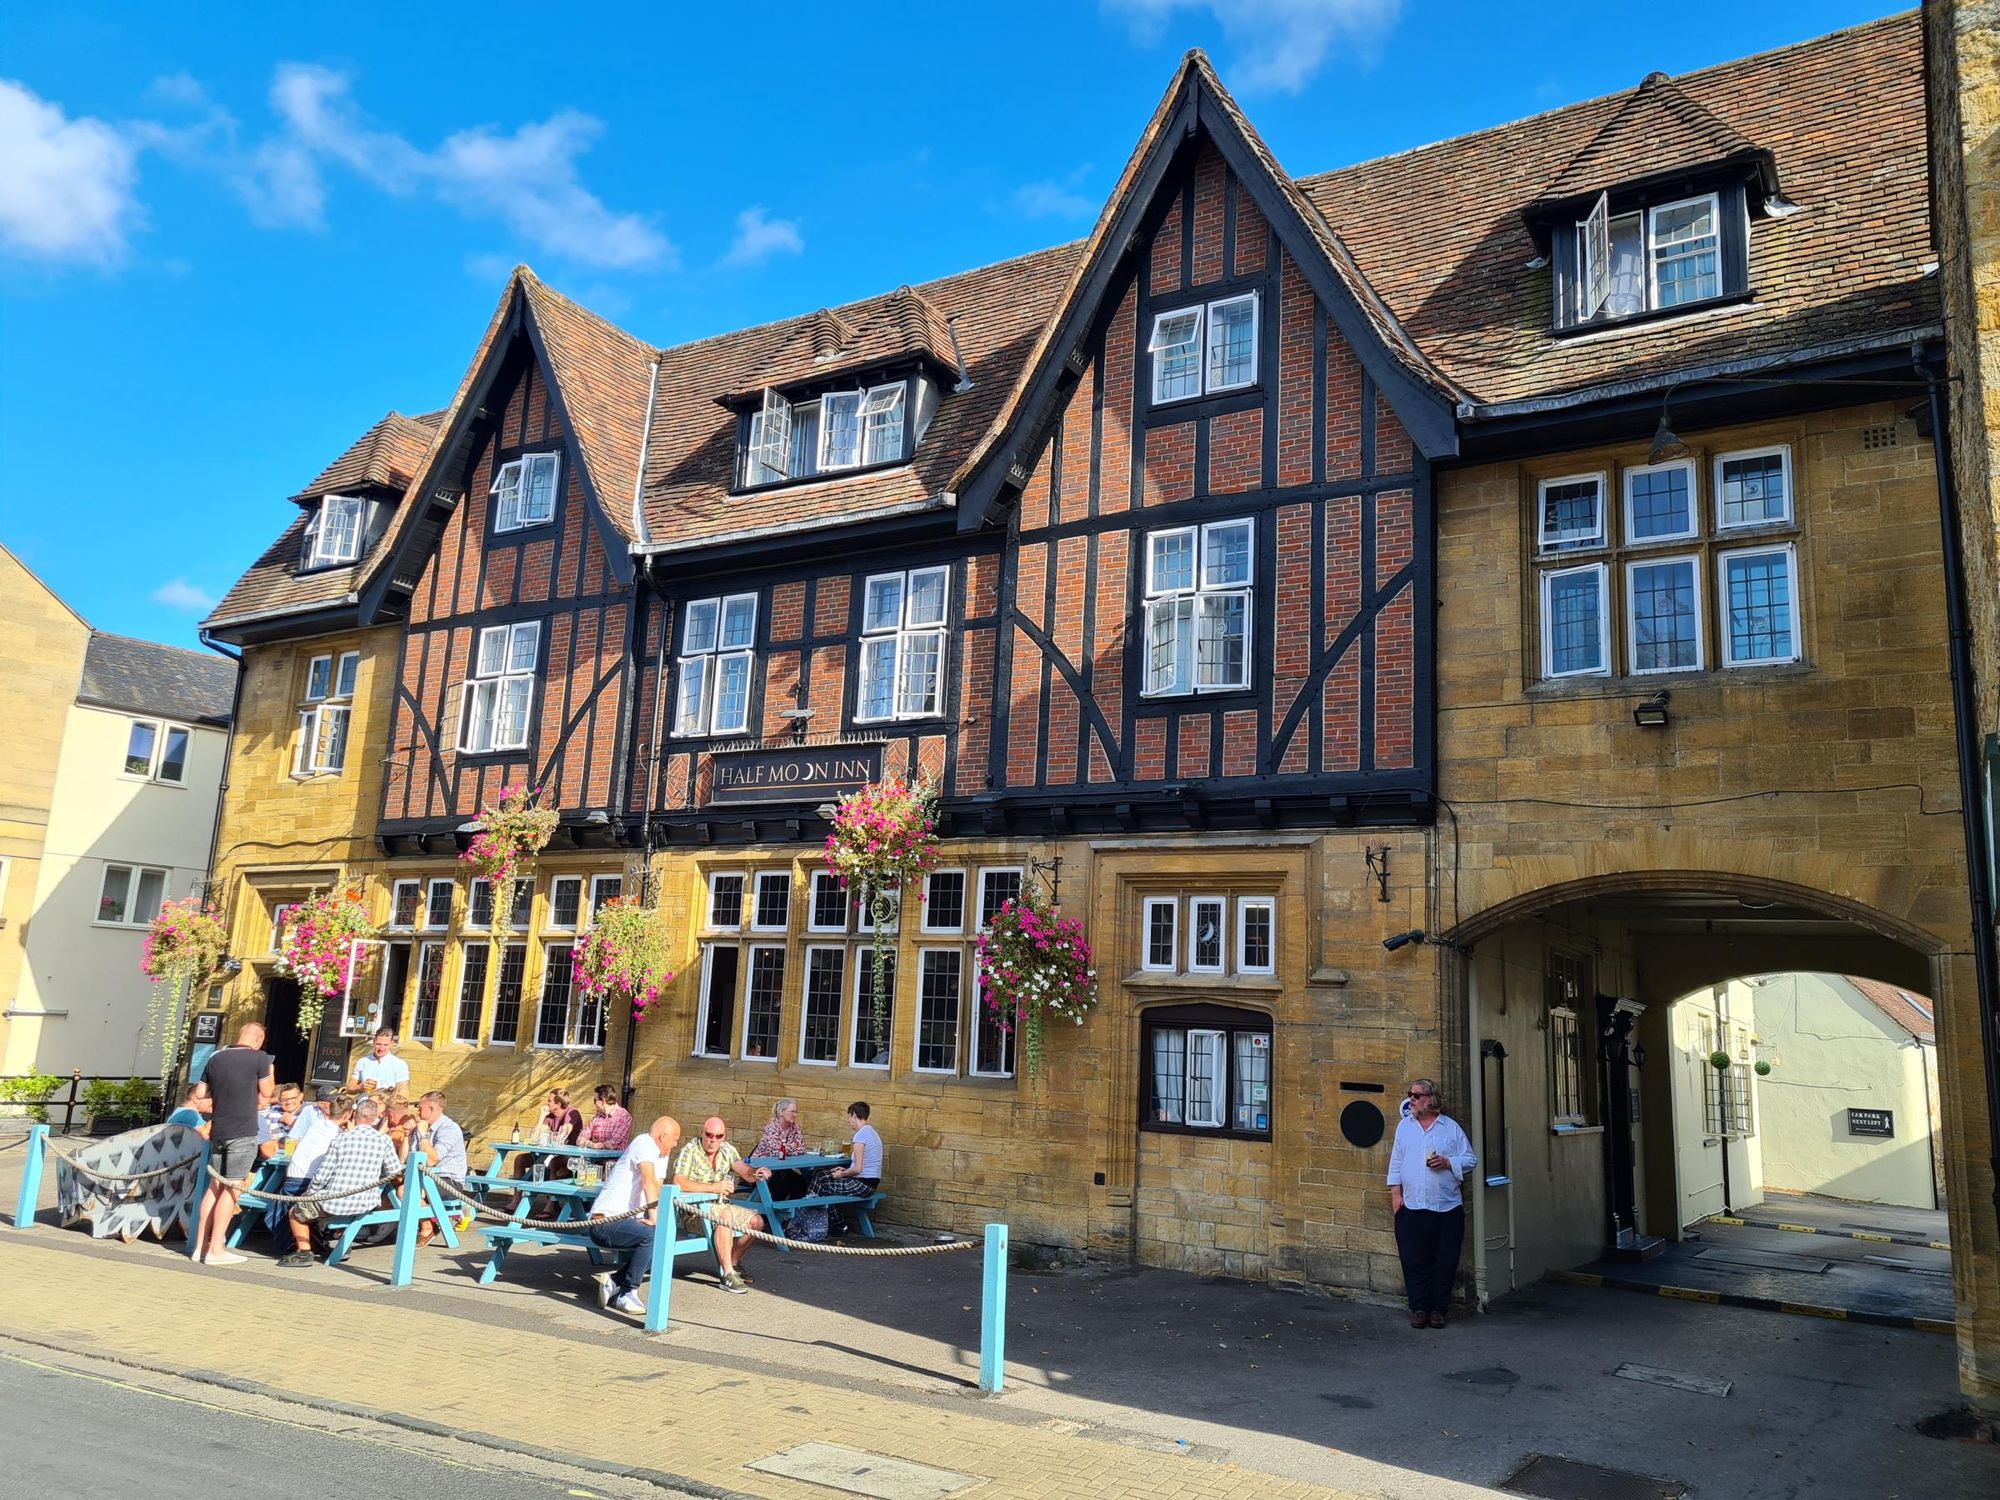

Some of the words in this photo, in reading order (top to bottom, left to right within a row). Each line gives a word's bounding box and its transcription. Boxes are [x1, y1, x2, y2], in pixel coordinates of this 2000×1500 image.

[720, 765, 765, 785] HALF
[768, 762, 829, 782] MOON
[834, 759, 871, 779] INN
